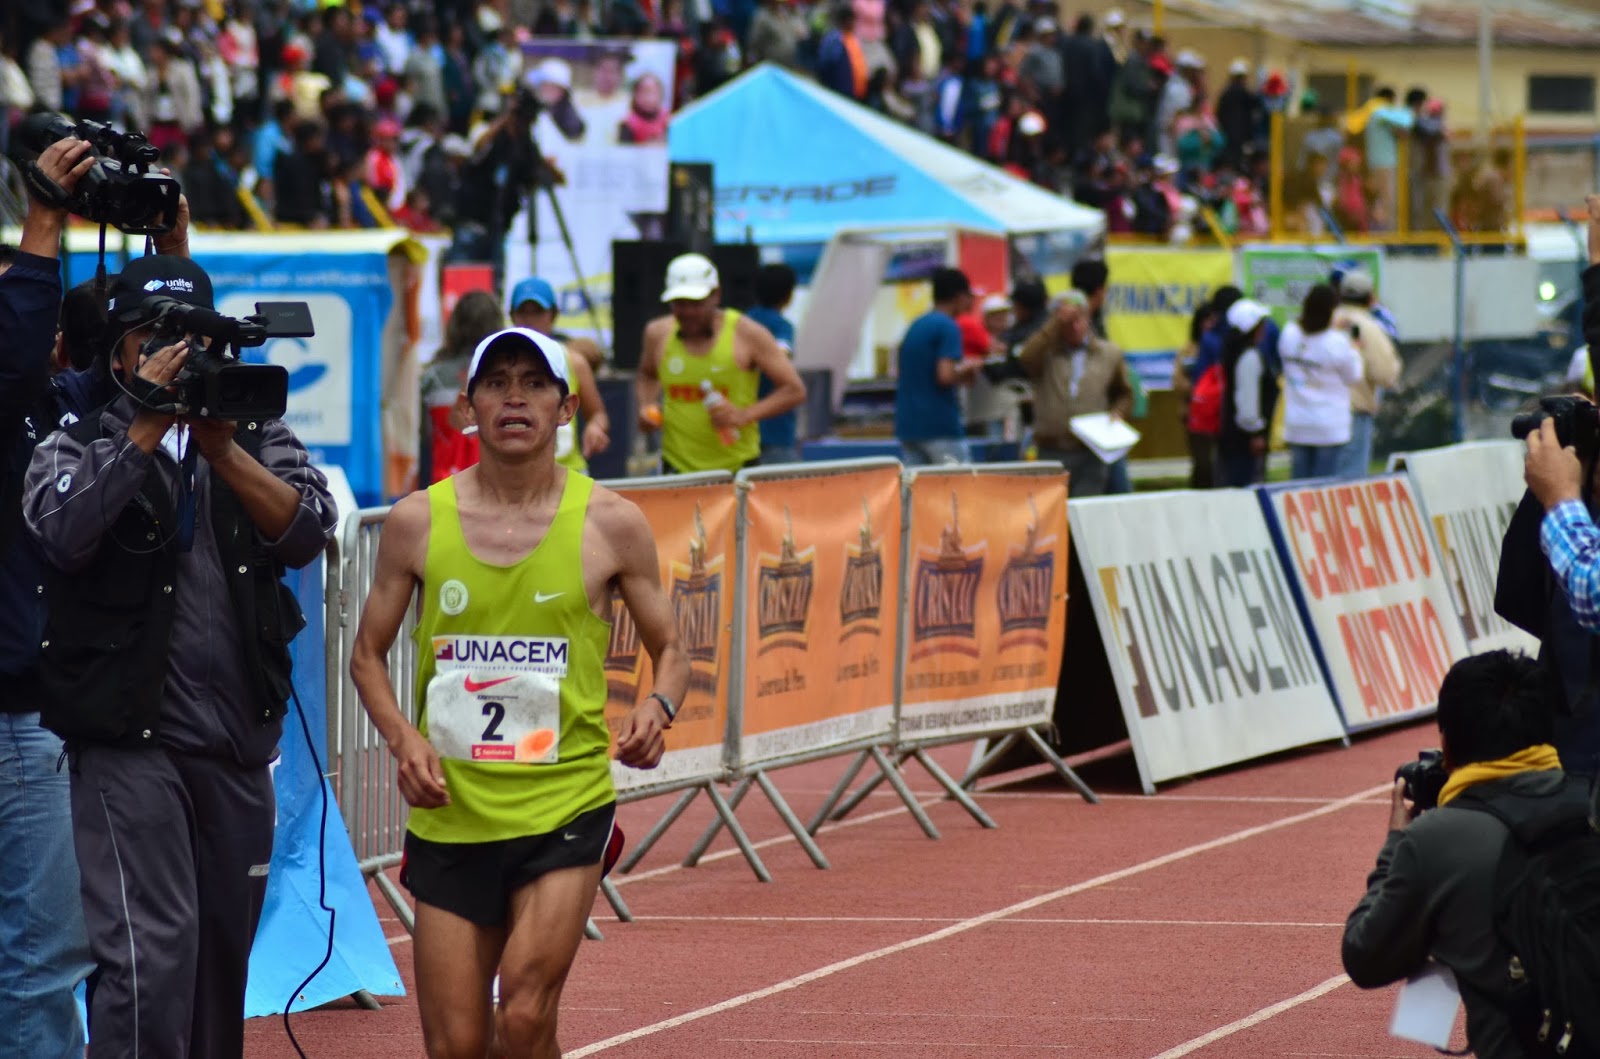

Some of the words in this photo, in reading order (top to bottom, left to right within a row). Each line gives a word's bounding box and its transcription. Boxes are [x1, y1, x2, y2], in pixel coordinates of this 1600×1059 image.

[713, 173, 898, 205] ERADE
[166, 278, 193, 289] unitel
[1283, 479, 1431, 600] CEMENTO
[1126, 549, 1318, 712] UNACEM
[455, 639, 567, 664] UNACEM
[1336, 596, 1455, 719] ANDINO
[481, 701, 505, 741] 2
